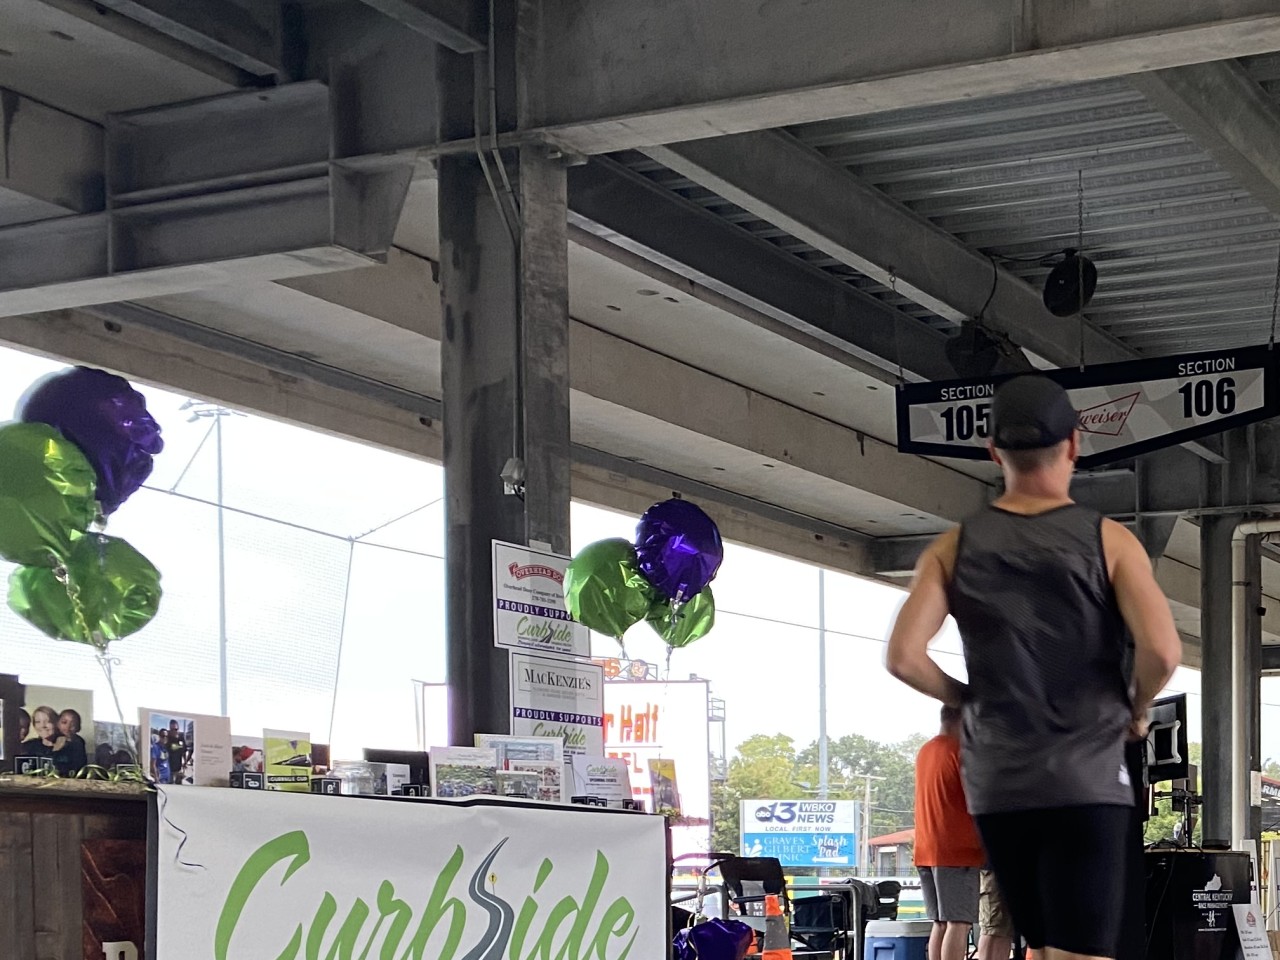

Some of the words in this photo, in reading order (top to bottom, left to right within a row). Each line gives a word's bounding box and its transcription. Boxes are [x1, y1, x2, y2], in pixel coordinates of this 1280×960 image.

[1178, 357, 1236, 376] SECTION
[941, 383, 994, 401] SECTION
[1178, 377, 1236, 419] 106
[1079, 408, 1128, 425] weiser
[499, 600, 540, 615] PROUDLY
[543, 608, 572, 621] SUPPO
[515, 707, 555, 721] PROUDLY
[559, 714, 602, 727] SUPPORTS
[801, 803, 834, 812] WBKO
[797, 813, 835, 824] NEWS
[763, 836, 805, 845] GRAVES
[811, 834, 849, 848] Splash
[763, 844, 811, 854] GILBERT
[819, 845, 839, 857] Pad
